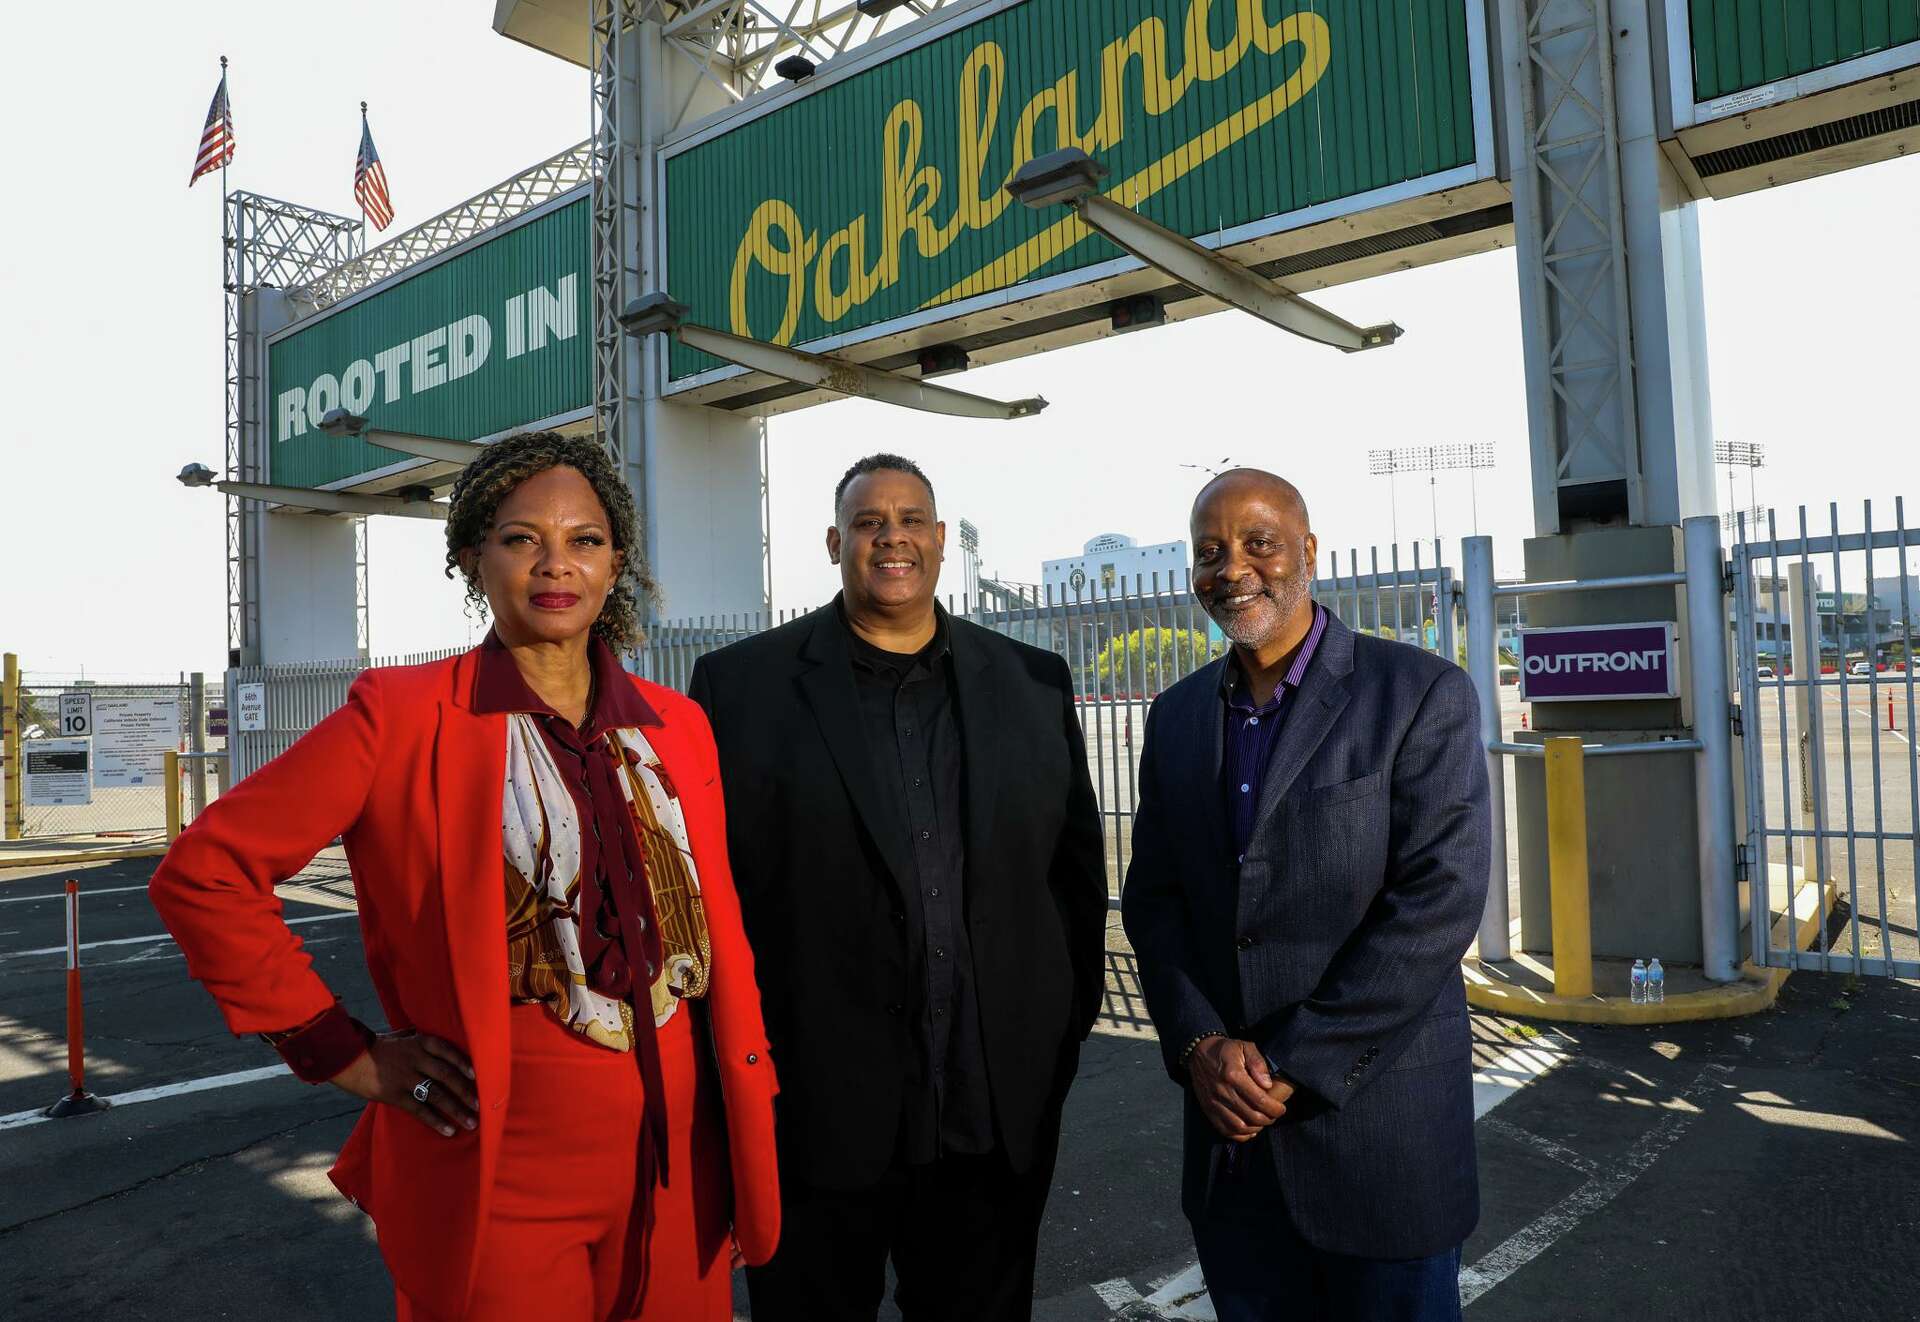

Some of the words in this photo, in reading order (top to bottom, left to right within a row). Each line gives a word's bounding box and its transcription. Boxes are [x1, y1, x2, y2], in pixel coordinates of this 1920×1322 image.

[729, 0, 1331, 347] Oakland
[278, 314, 492, 443] ROOTED
[505, 272, 578, 360] IN
[1524, 650, 1666, 675] OUTFRONT
[64, 697, 86, 705] SPEED
[241, 703, 262, 711] Avenue
[67, 706, 84, 714] LIMIT
[244, 712, 259, 721] GATE
[65, 716, 86, 732] 10
